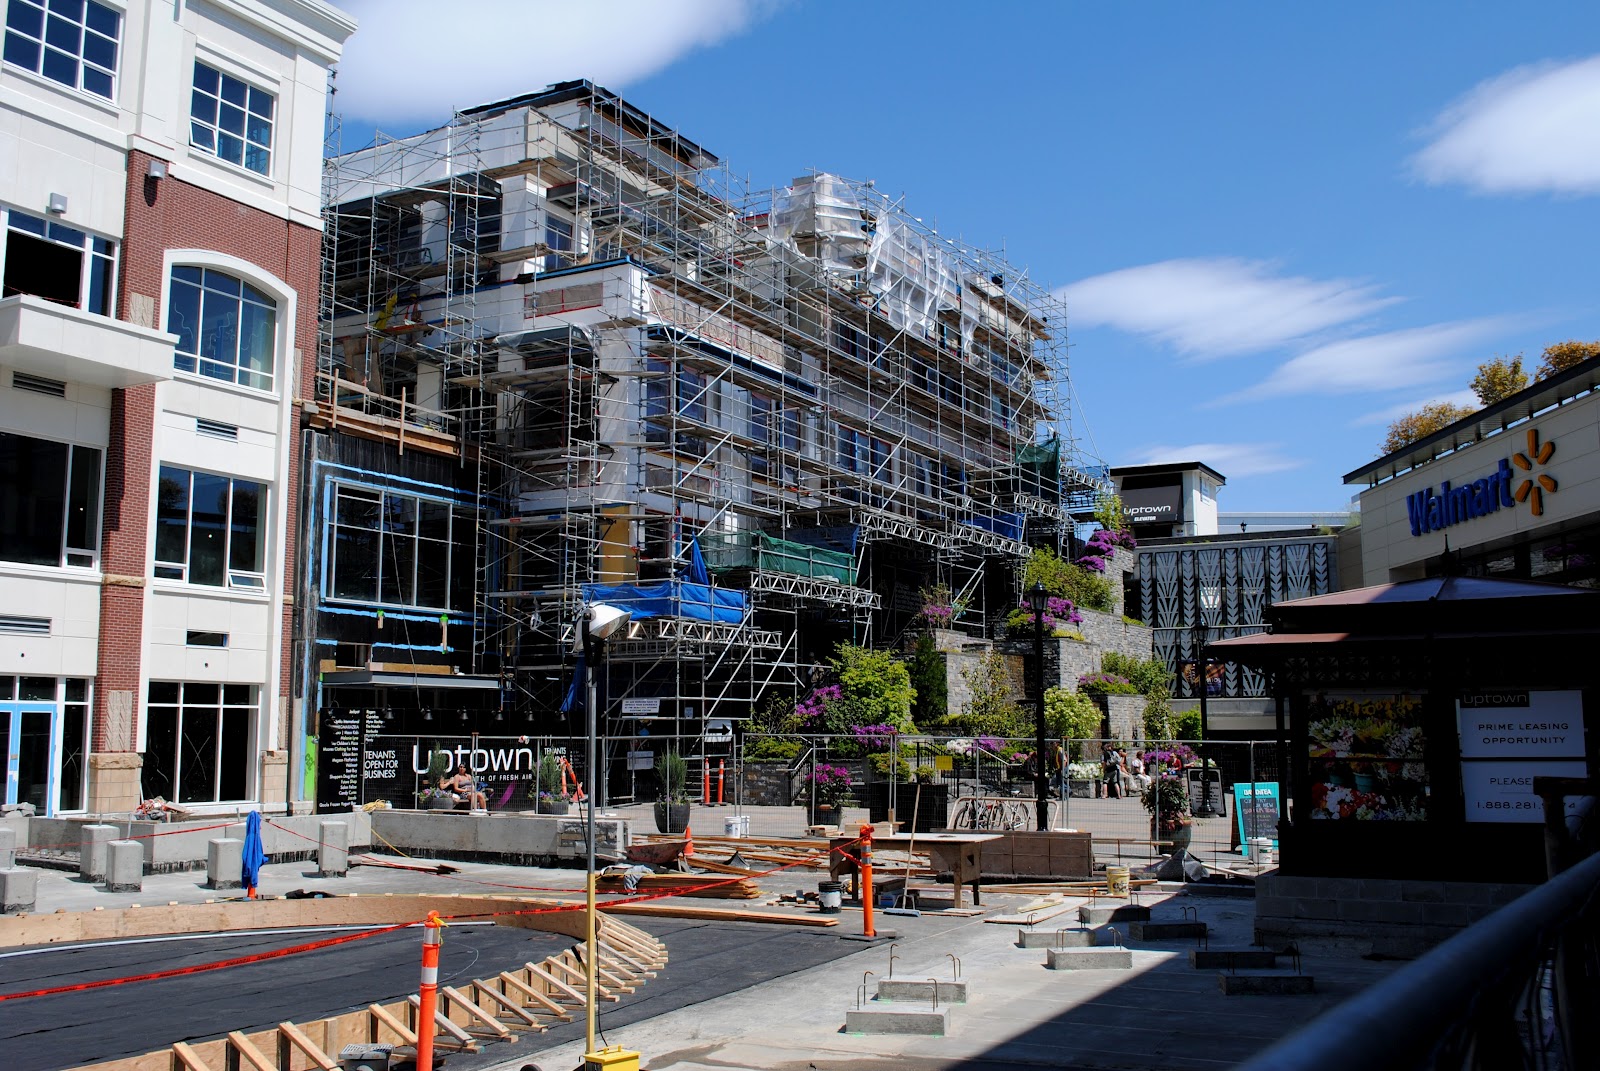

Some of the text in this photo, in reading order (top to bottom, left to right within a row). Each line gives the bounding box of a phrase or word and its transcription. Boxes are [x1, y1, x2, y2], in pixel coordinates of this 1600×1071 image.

[1406, 458, 1515, 537] Walmart
[1123, 505, 1171, 516] uptown
[1463, 694, 1527, 707] uptown
[1478, 722, 1569, 731] PRIME LEASING
[1482, 736, 1566, 744] OPPORTUNITY
[365, 750, 395, 759] TENANTS
[364, 760, 398, 769] OPEN FOR
[364, 769, 396, 778] BUSINESS
[1489, 777, 1532, 785] PLEASE
[1477, 801, 1576, 809] 1.888.281.4
